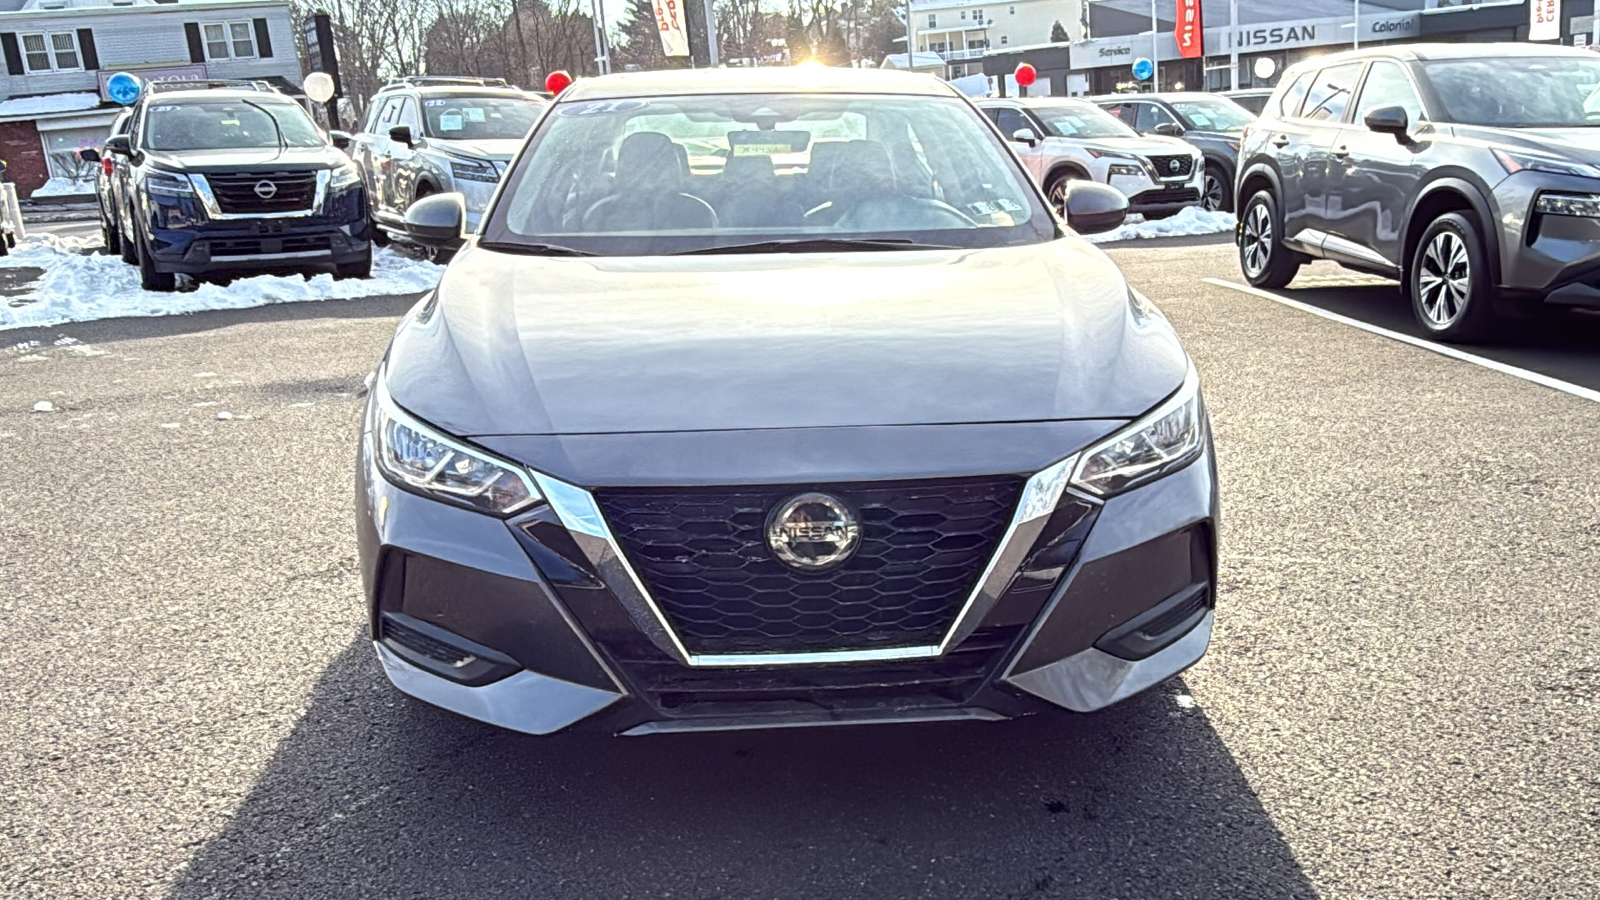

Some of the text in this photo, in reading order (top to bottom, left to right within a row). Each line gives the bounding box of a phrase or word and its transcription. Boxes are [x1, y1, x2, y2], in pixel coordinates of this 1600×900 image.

[1372, 18, 1414, 33] Colonial
[1229, 25, 1316, 48] NISSAN
[1098, 46, 1131, 57] Service
[778, 526, 849, 540] NISSAN
